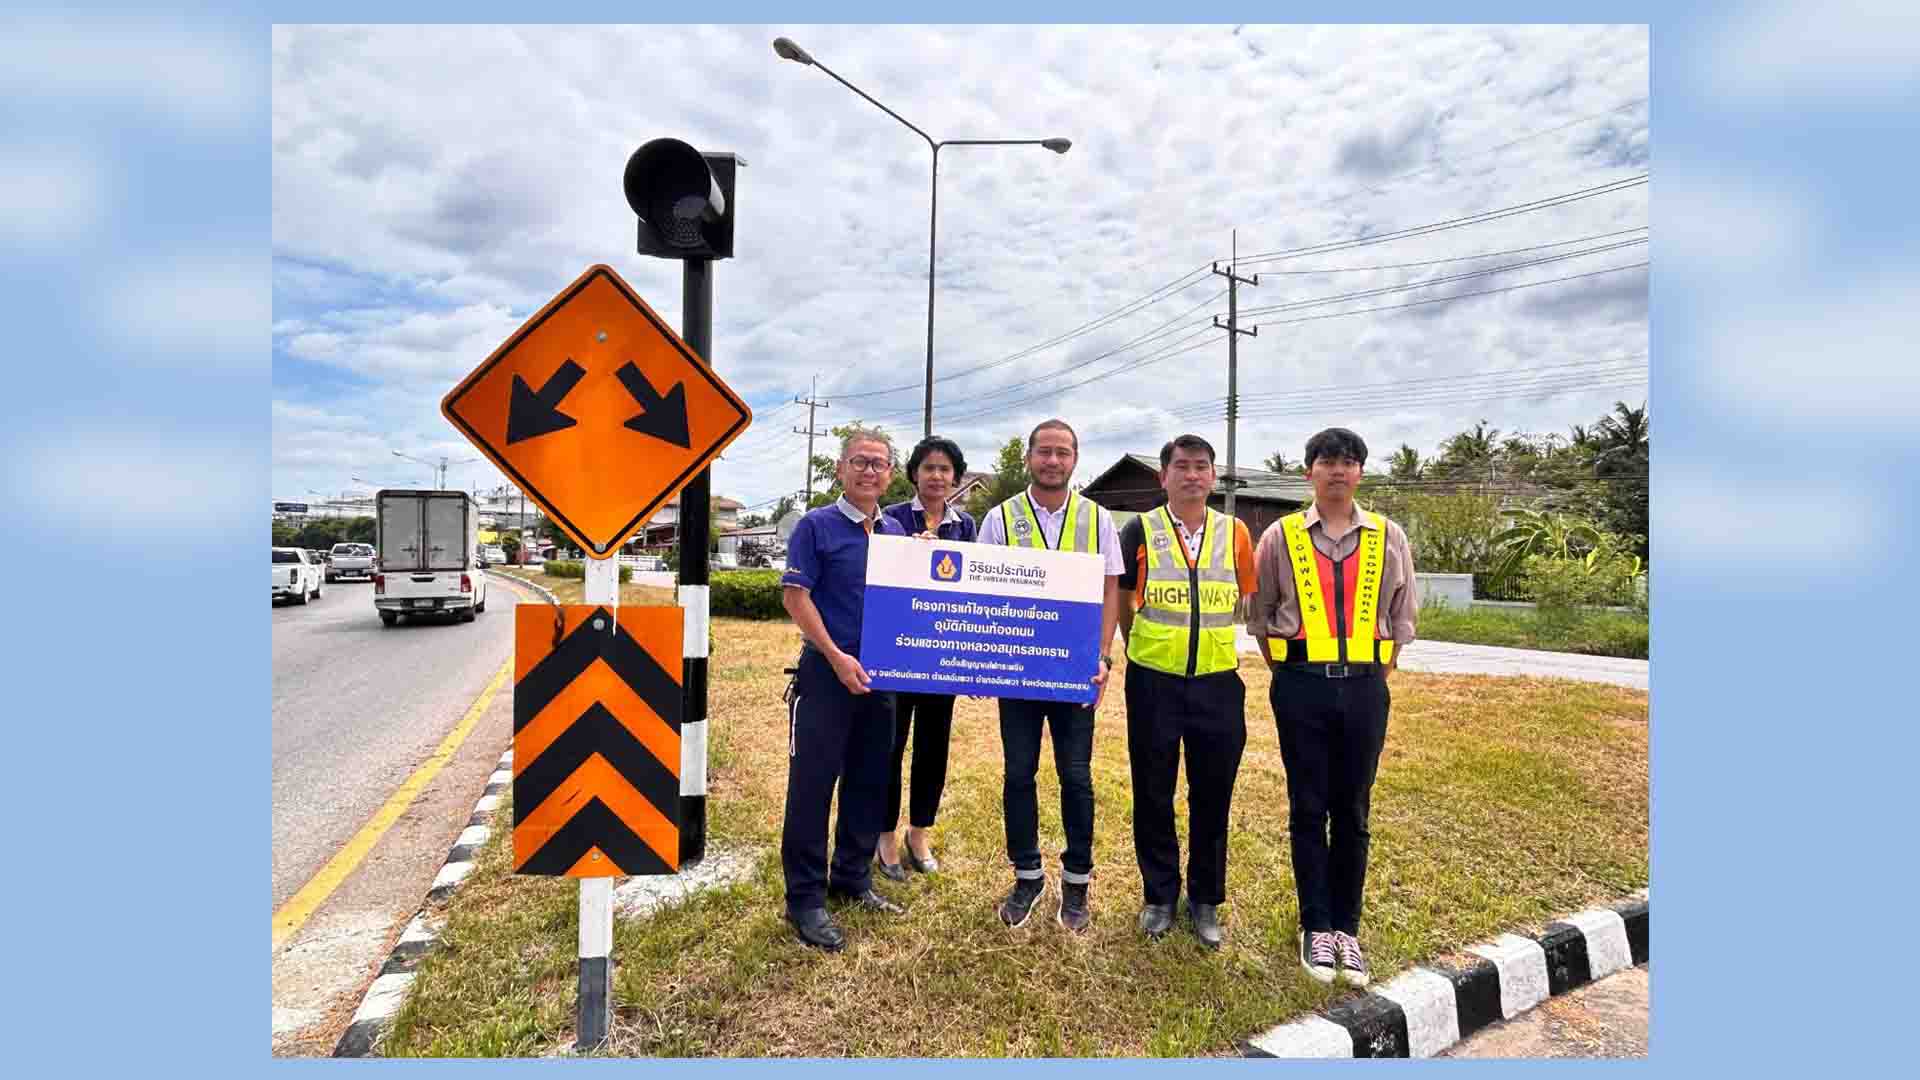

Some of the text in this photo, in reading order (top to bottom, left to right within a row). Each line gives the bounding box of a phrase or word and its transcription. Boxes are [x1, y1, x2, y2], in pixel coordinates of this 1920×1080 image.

[969, 560, 1047, 579] วิริยะประกันภัย
[969, 574, 981, 582] THE
[1360, 528, 1377, 622] MUTSONGKHRAM
[911, 597, 1059, 622] โครงการแก้ไขจุดเสี่ยงเพื่อลด
[934, 618, 1035, 637] อุบัติภัยบนท้องถนน
[895, 633, 1069, 658] ร่วมแขวงทางหลวงสมุทรสงคราม
